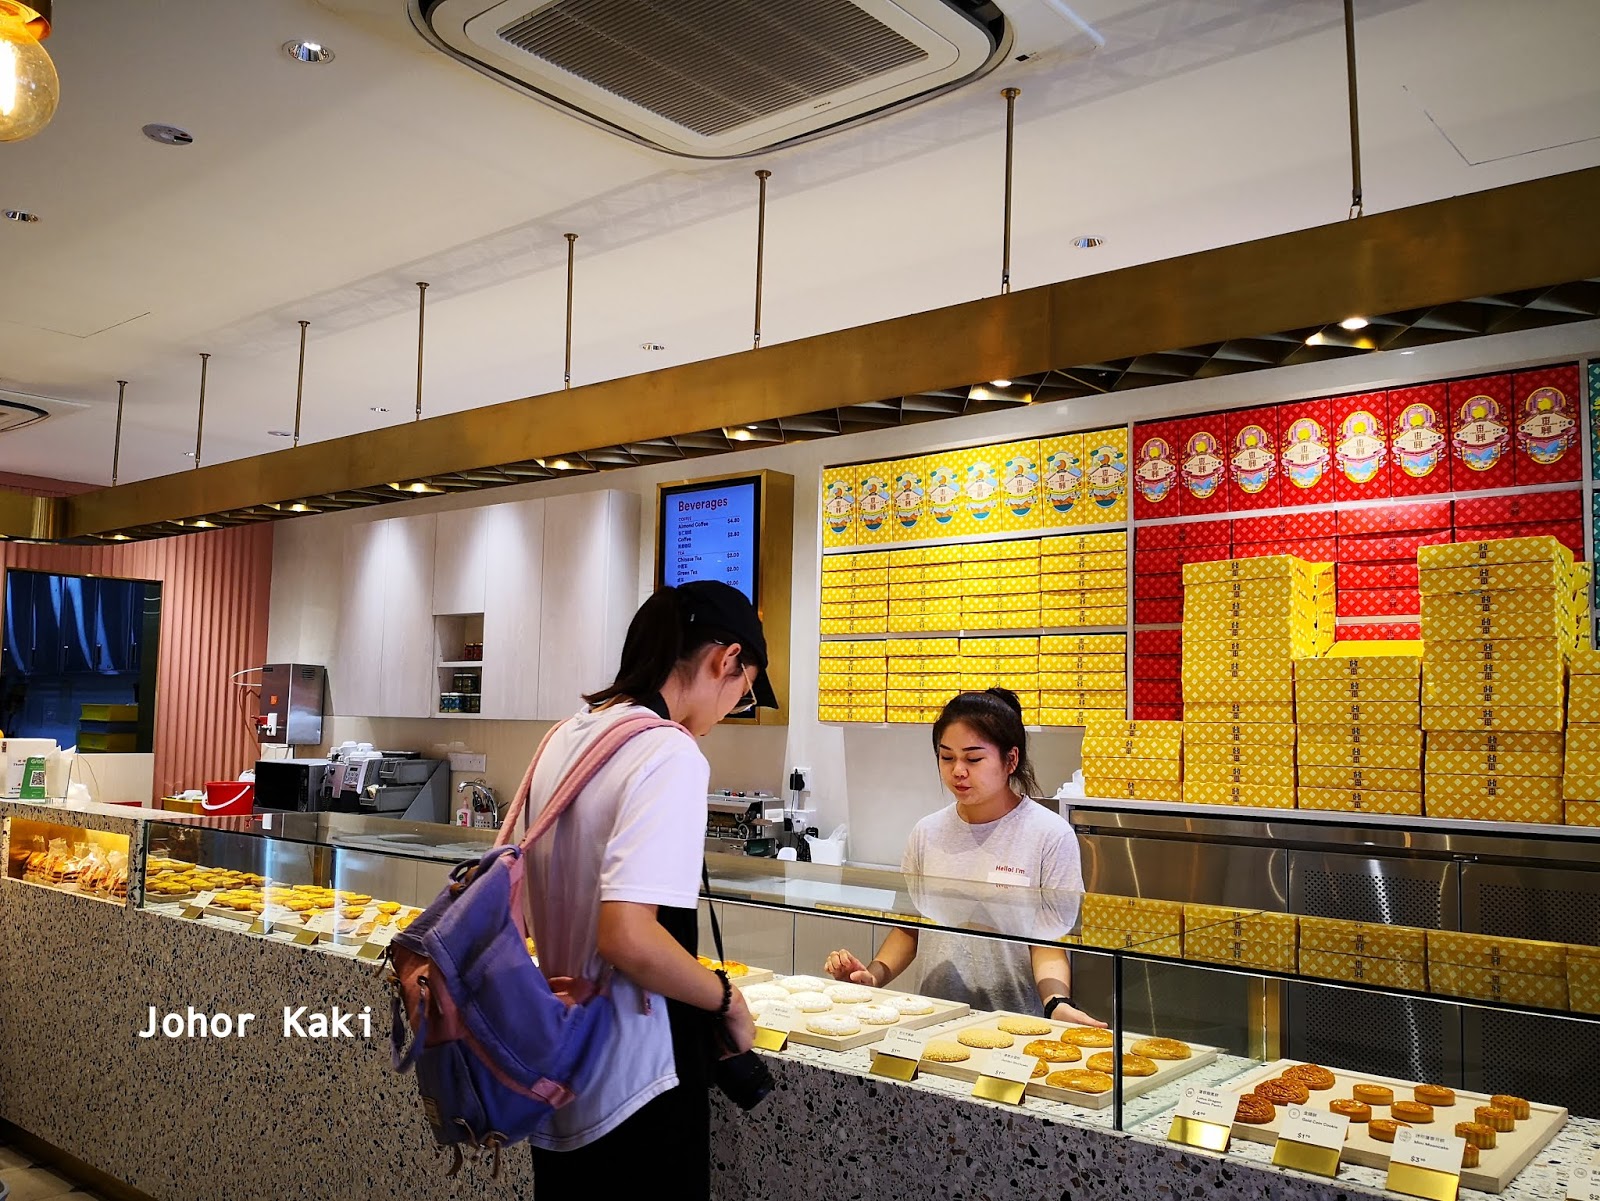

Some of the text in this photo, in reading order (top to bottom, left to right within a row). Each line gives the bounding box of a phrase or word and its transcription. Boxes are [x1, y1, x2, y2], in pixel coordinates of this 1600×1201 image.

[678, 498, 728, 512] Beverages
[995, 864, 1026, 875] Hello! I'm
